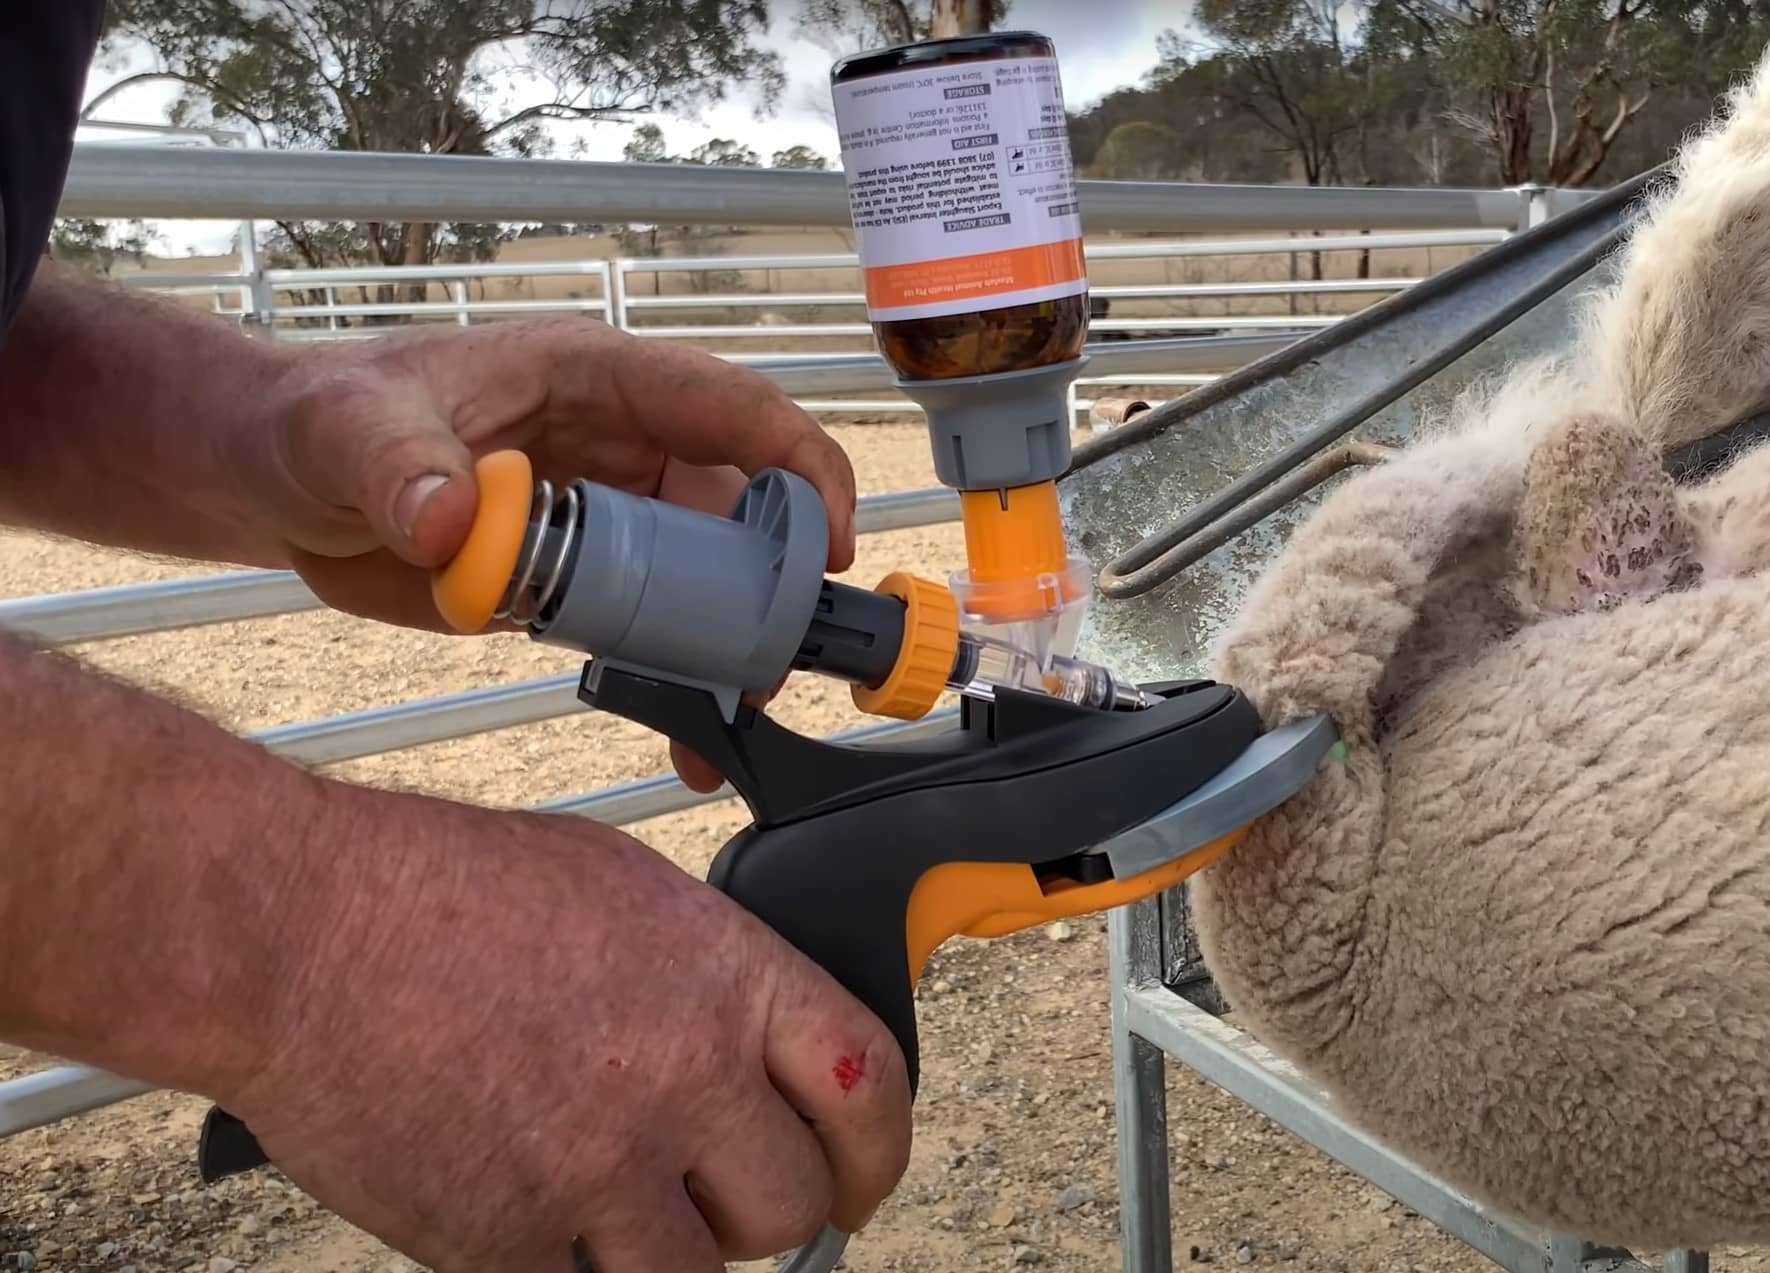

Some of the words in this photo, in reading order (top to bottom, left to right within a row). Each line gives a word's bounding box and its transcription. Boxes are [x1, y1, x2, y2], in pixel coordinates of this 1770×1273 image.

[935, 74, 960, 84] below
[962, 72, 981, 80] Store
[945, 85, 984, 99] STORAGE
[905, 117, 949, 129] Information
[952, 113, 980, 123] Poisons
[938, 127, 951, 135] not
[960, 125, 972, 133] aid
[974, 122, 989, 131] First
[904, 128, 936, 140] generally
[953, 138, 969, 148] AID
[970, 135, 992, 146] FIRST
[958, 155, 976, 164] 3808
[979, 151, 994, 161] (07)
[890, 163, 908, 172] using
[910, 161, 935, 170] before
[936, 158, 955, 167] 1399
[971, 162, 995, 171] advice
[905, 171, 929, 181] sought
[932, 170, 941, 178] be
[943, 166, 969, 176] should
[888, 175, 904, 184] from
[954, 173, 986, 184] mitigate
[898, 184, 913, 192] risks
[916, 178, 950, 190] potential
[979, 182, 998, 191] meat
[901, 192, 923, 201] period
[928, 186, 974, 198] withholding
[884, 195, 897, 203] may
[943, 199, 954, 207] for
[956, 192, 1000, 204] established
[895, 202, 923, 212] product.
[926, 201, 940, 209] this
[977, 201, 1001, 211] Export
[938, 205, 975, 217] Slaughter
[909, 212, 937, 221] Interval
[979, 215, 1003, 226] TRADE
[946, 219, 976, 230] ADVICE
[915, 286, 927, 296] Pty
